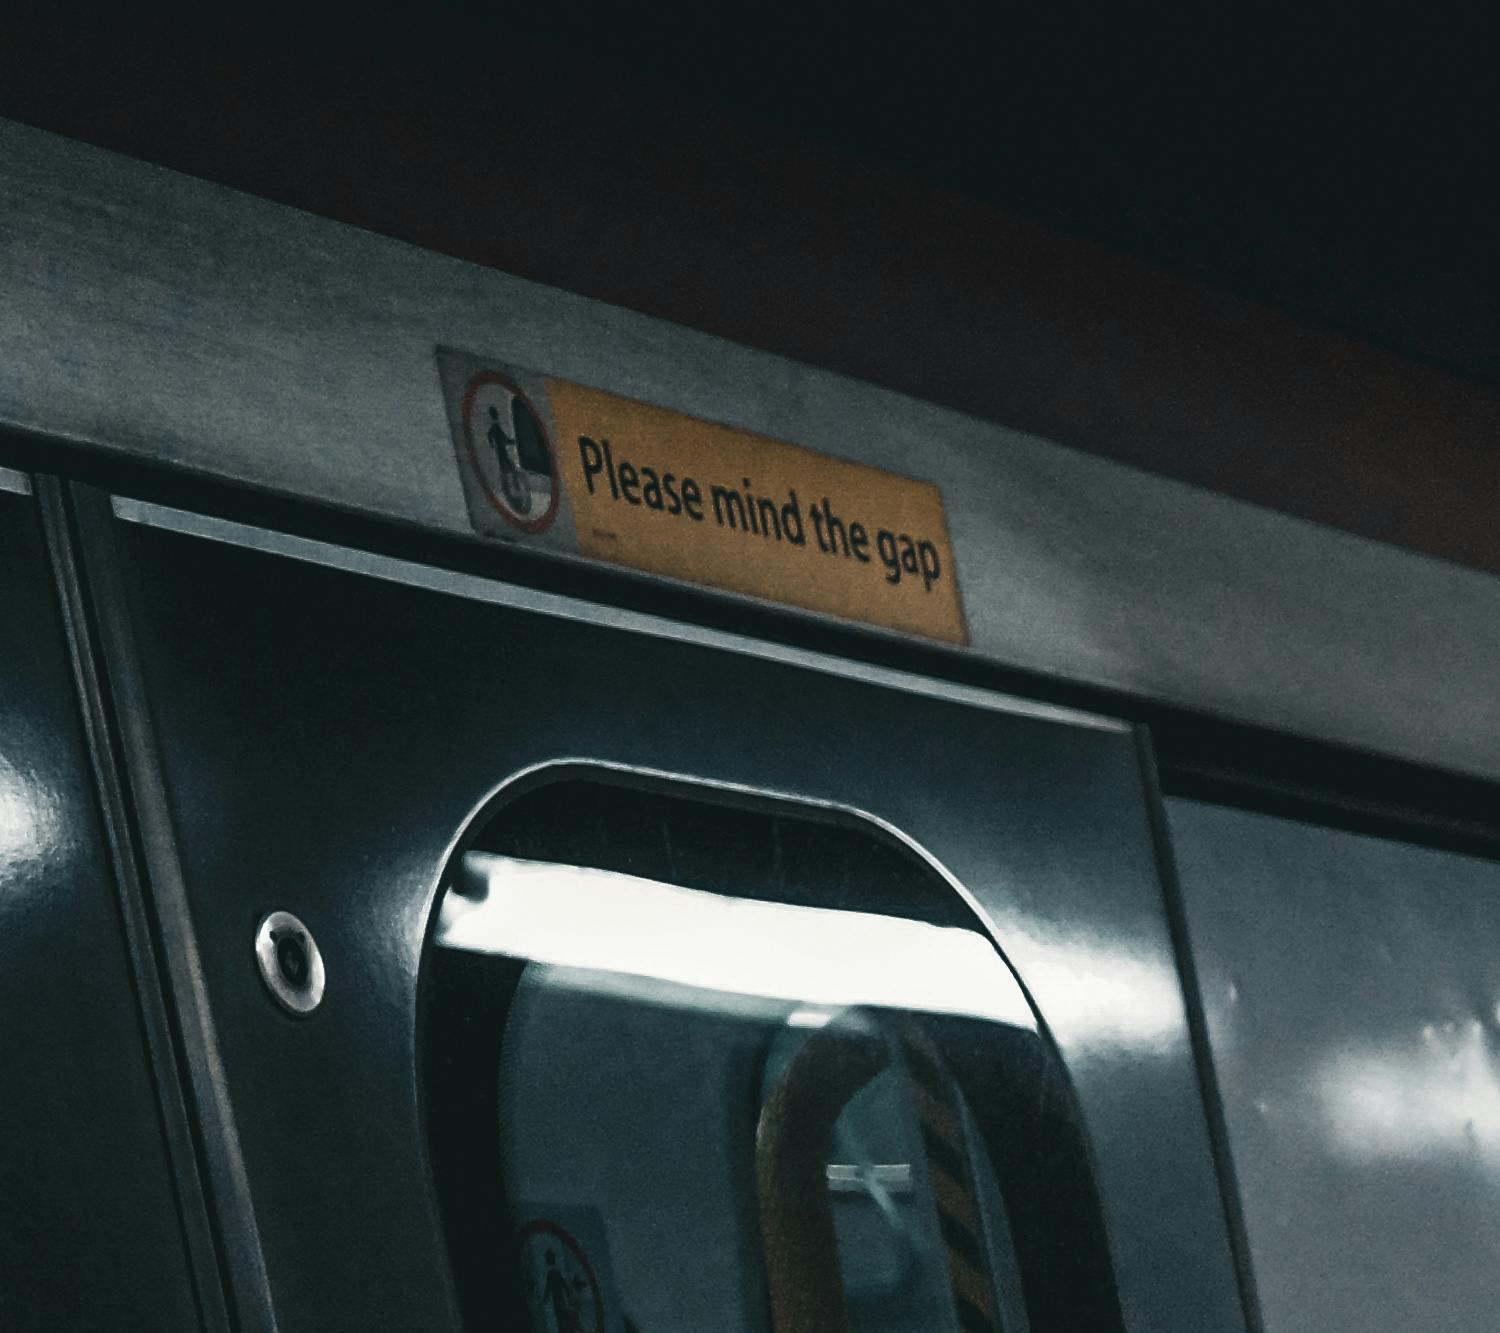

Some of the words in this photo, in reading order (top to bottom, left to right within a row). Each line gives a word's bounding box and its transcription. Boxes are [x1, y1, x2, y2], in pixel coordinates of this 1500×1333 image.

[578, 436, 703, 521] Please
[711, 478, 806, 546] mind
[811, 499, 870, 563] the
[877, 532, 942, 592] gap
